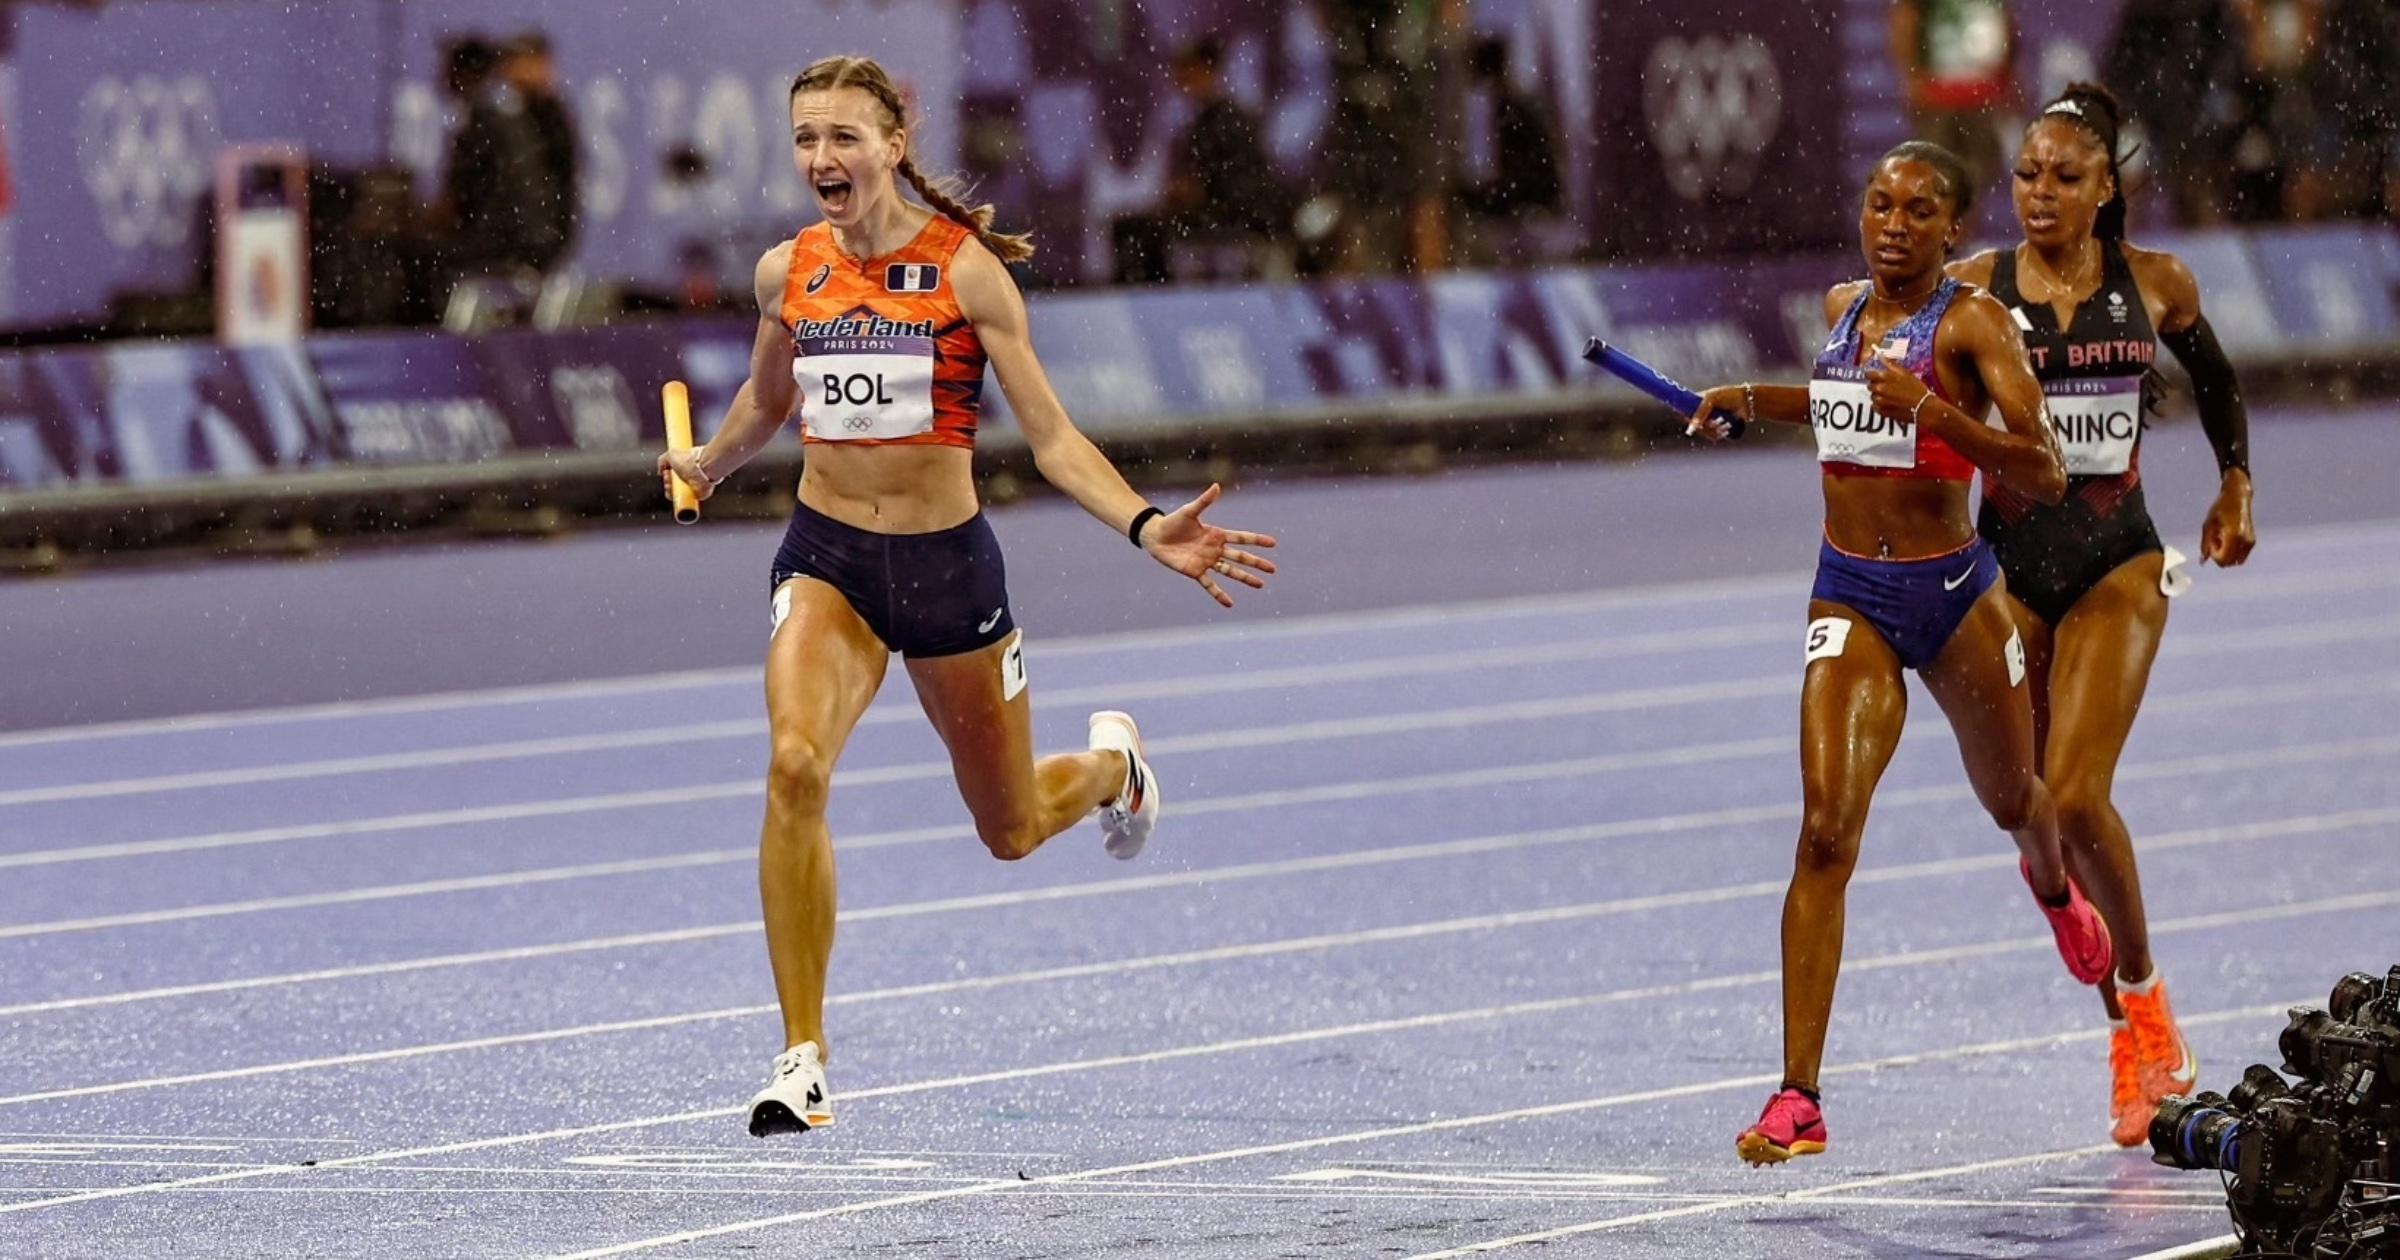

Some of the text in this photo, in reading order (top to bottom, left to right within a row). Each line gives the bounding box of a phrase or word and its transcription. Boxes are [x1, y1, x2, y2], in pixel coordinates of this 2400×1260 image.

[823, 340, 894, 350] PARIS 2024
[2067, 340, 2154, 367] BRITAIN
[823, 373, 893, 405] BOL
[2053, 411, 2133, 443] NING
[1809, 625, 1829, 652] 5
